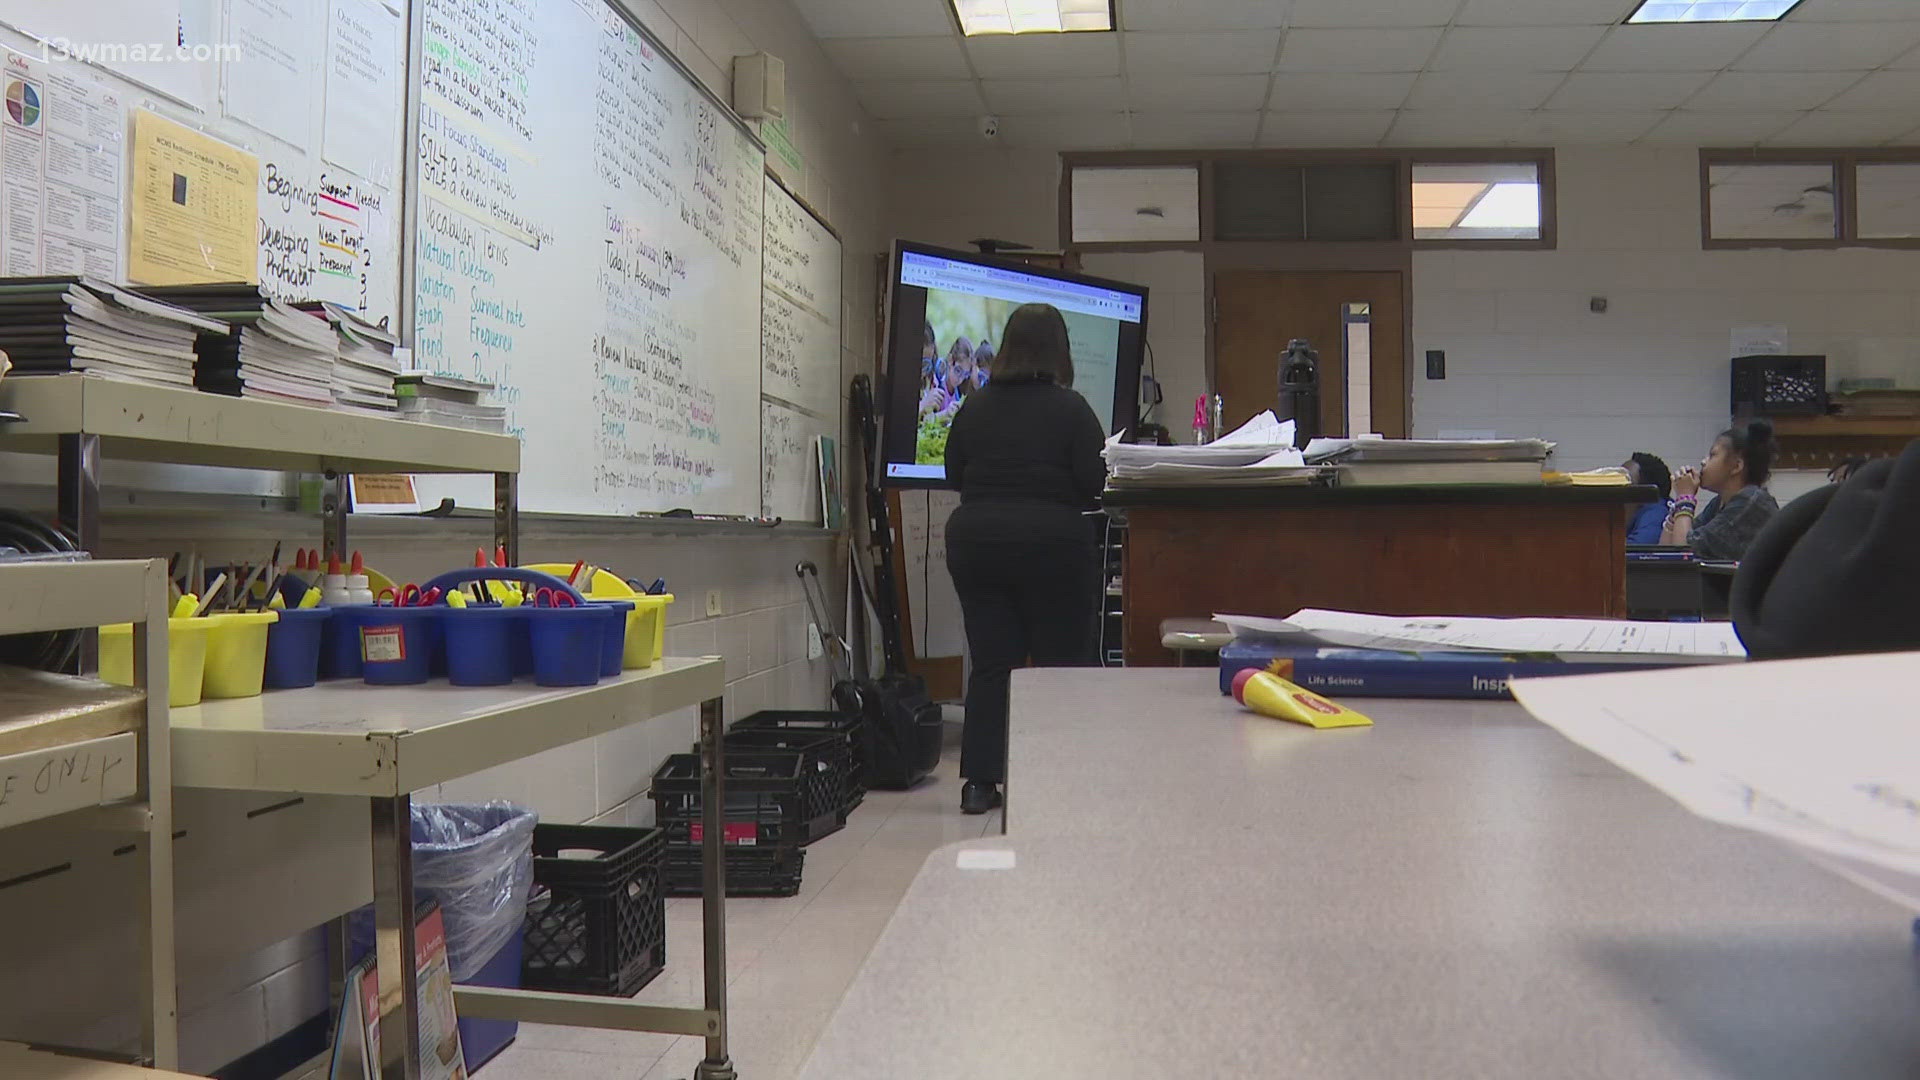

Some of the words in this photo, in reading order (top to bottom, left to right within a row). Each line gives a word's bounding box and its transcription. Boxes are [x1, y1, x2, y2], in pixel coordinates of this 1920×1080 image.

[443, 115, 468, 148] Focus
[470, 133, 508, 175] Standard
[265, 163, 318, 216] Beginning
[319, 173, 352, 199] Support
[355, 187, 383, 216] Needed
[259, 217, 309, 268] Developing
[318, 223, 338, 244] Near
[340, 229, 364, 254] Target
[363, 249, 371, 267] 2
[424, 194, 478, 262] Vocabulary
[479, 226, 508, 267] Terms
[319, 251, 353, 276] Prepared
[360, 273, 367, 295] 3
[419, 228, 456, 273] Natural
[458, 249, 496, 289] Selection
[417, 263, 456, 305] Variation
[470, 285, 504, 321] Survival
[506, 298, 526, 328] rate
[415, 326, 444, 359] Trend
[1308, 675, 1326, 686] Life
[1328, 676, 1365, 687] Science
[34, 750, 122, 799] ONLY
